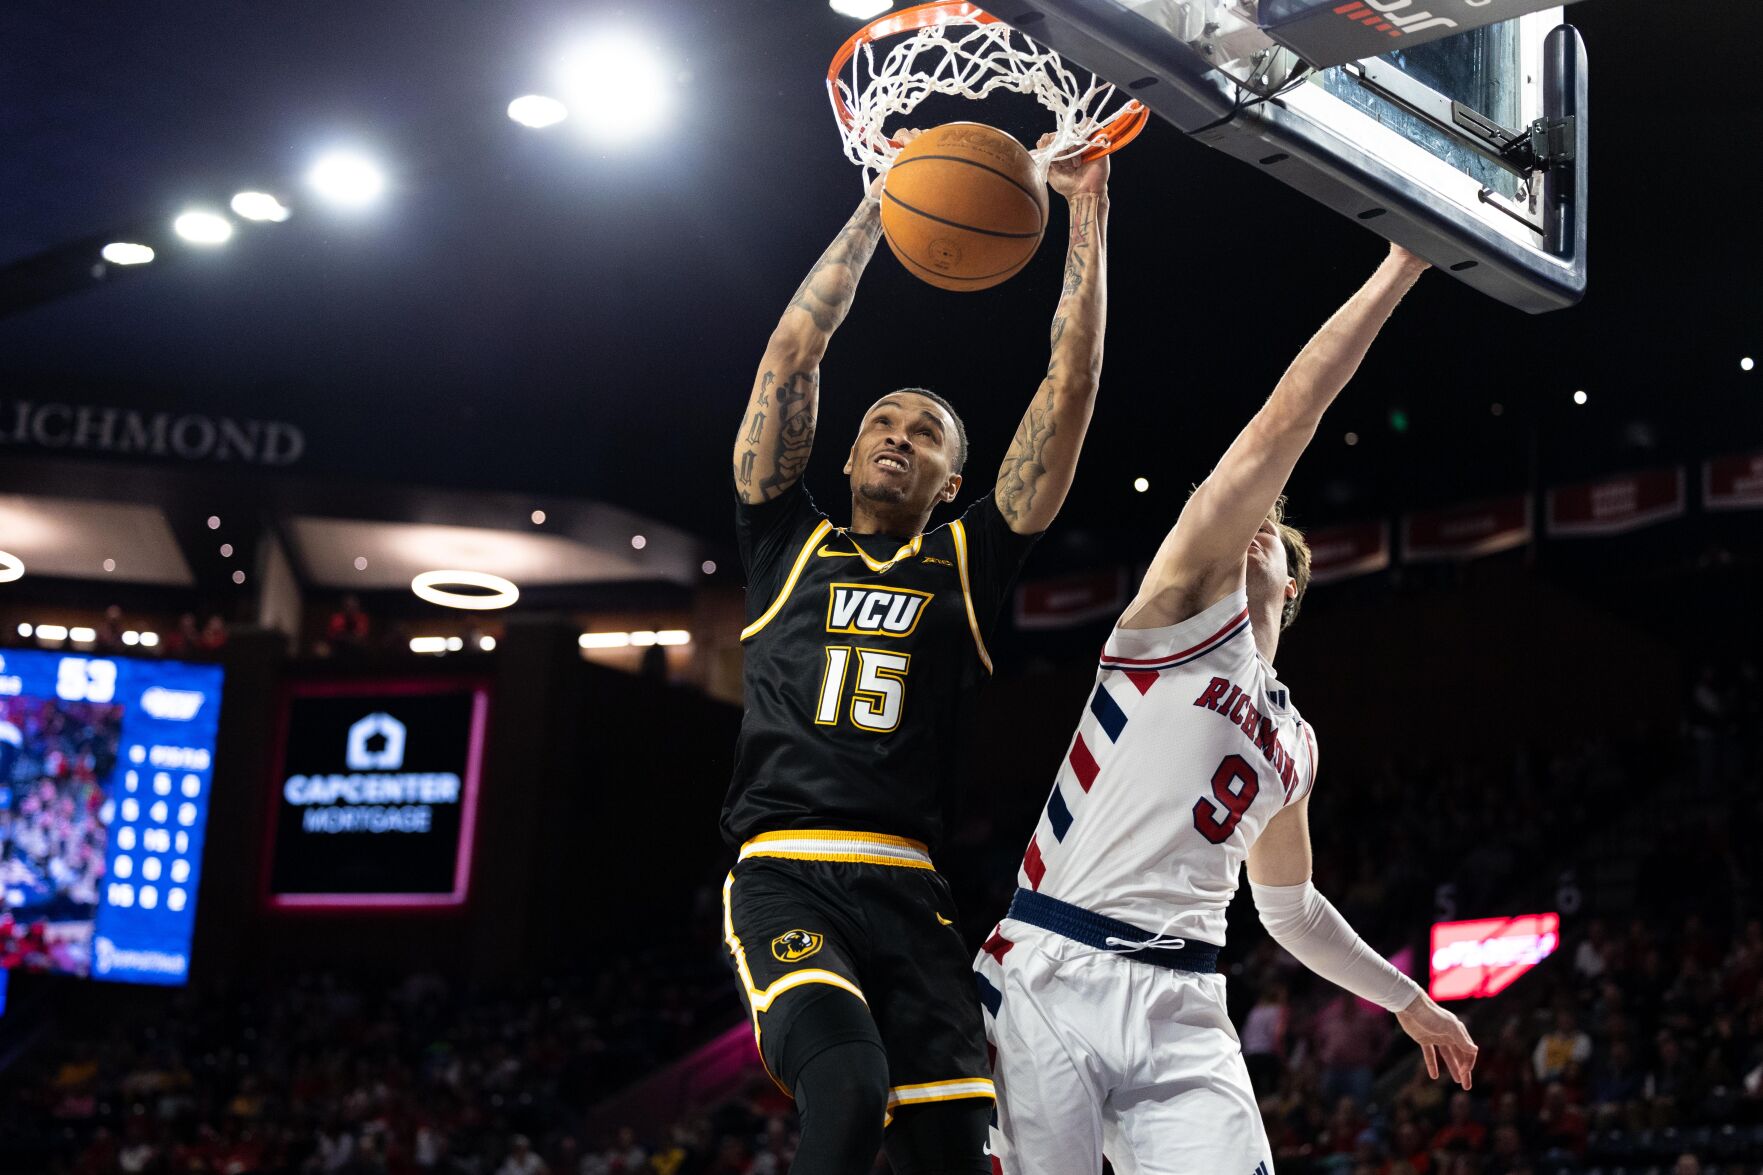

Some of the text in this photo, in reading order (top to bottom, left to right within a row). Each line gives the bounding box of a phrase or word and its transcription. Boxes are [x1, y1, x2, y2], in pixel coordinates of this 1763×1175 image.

[0, 399, 306, 466] ICHMOND
[830, 588, 926, 633] VCU
[815, 646, 911, 733] 15
[283, 773, 462, 806] CAPCENTER
[1192, 754, 1260, 845] 9
[303, 804, 433, 834] MORTGAGE
